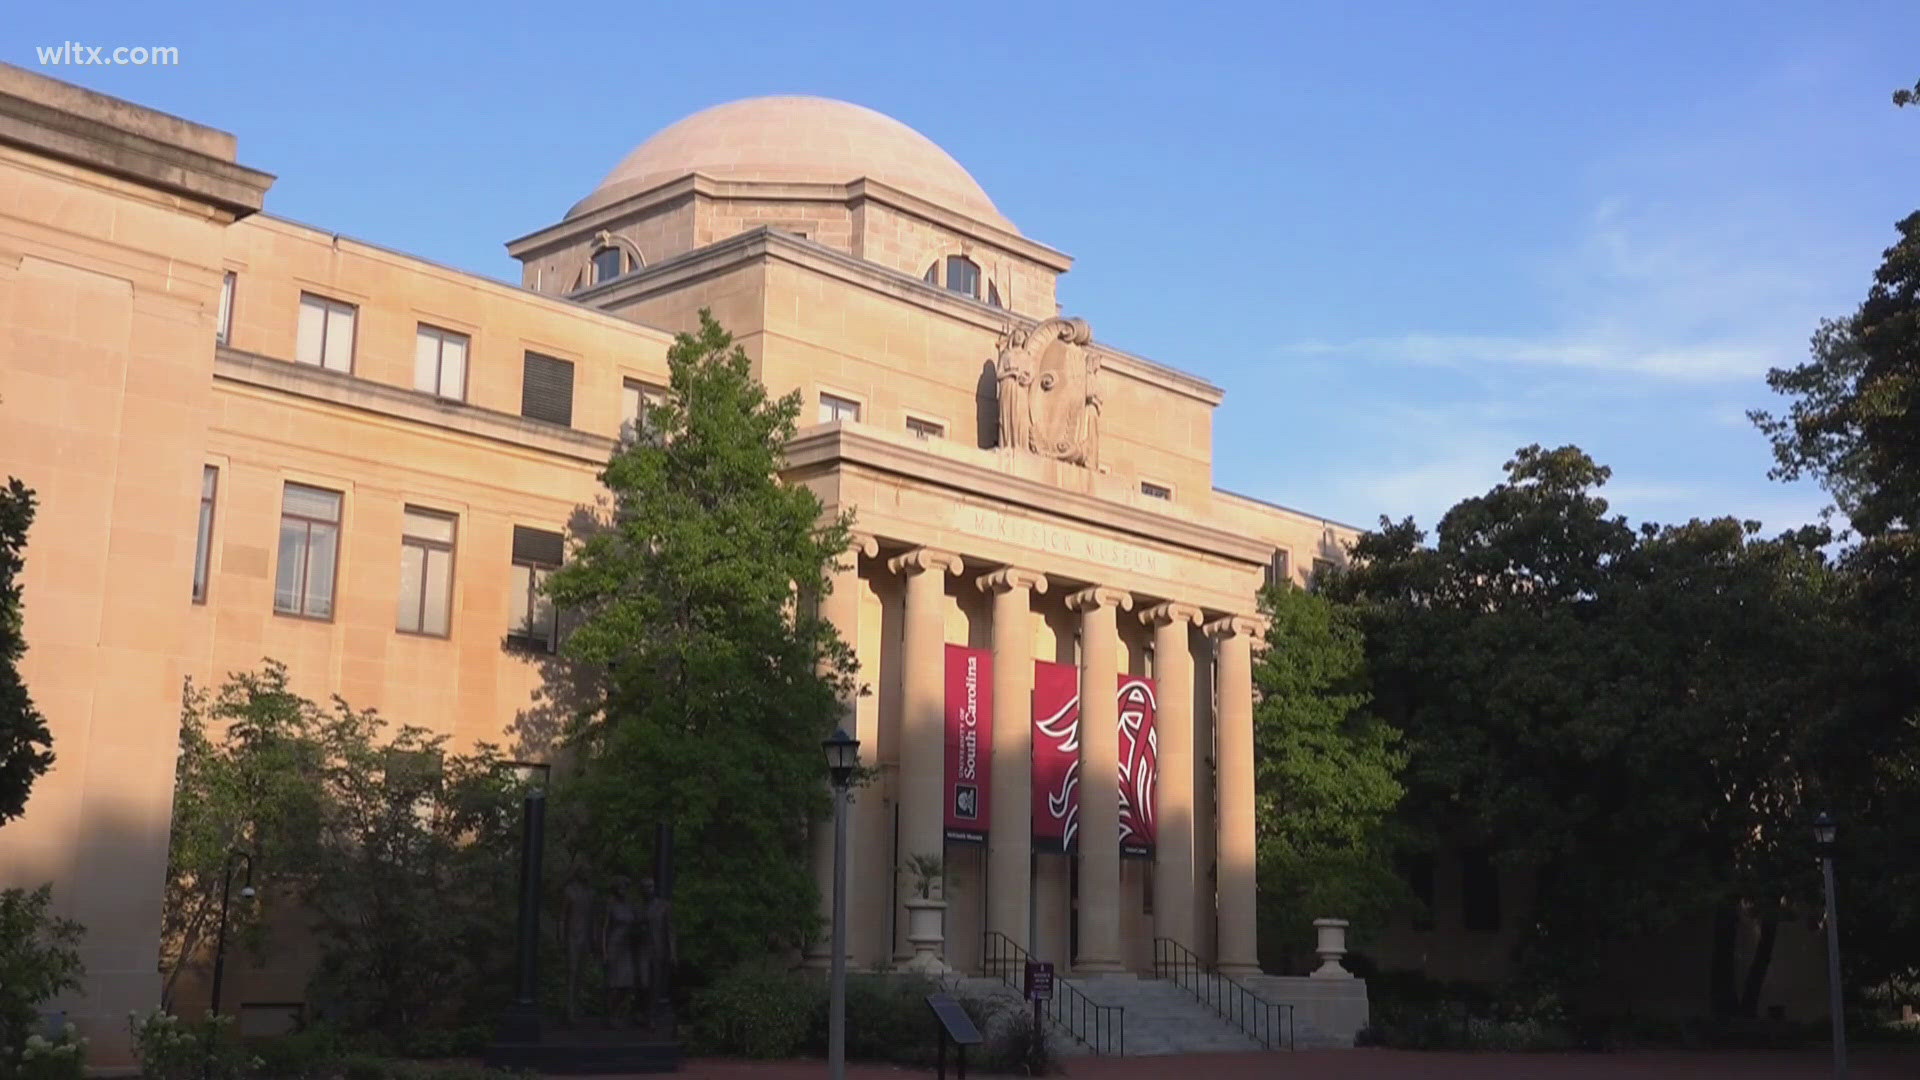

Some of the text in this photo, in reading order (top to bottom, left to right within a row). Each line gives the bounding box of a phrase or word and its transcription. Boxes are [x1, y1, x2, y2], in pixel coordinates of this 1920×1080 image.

[1086, 540, 1157, 570] MUSEUM
[964, 656, 977, 780] South Carolina
